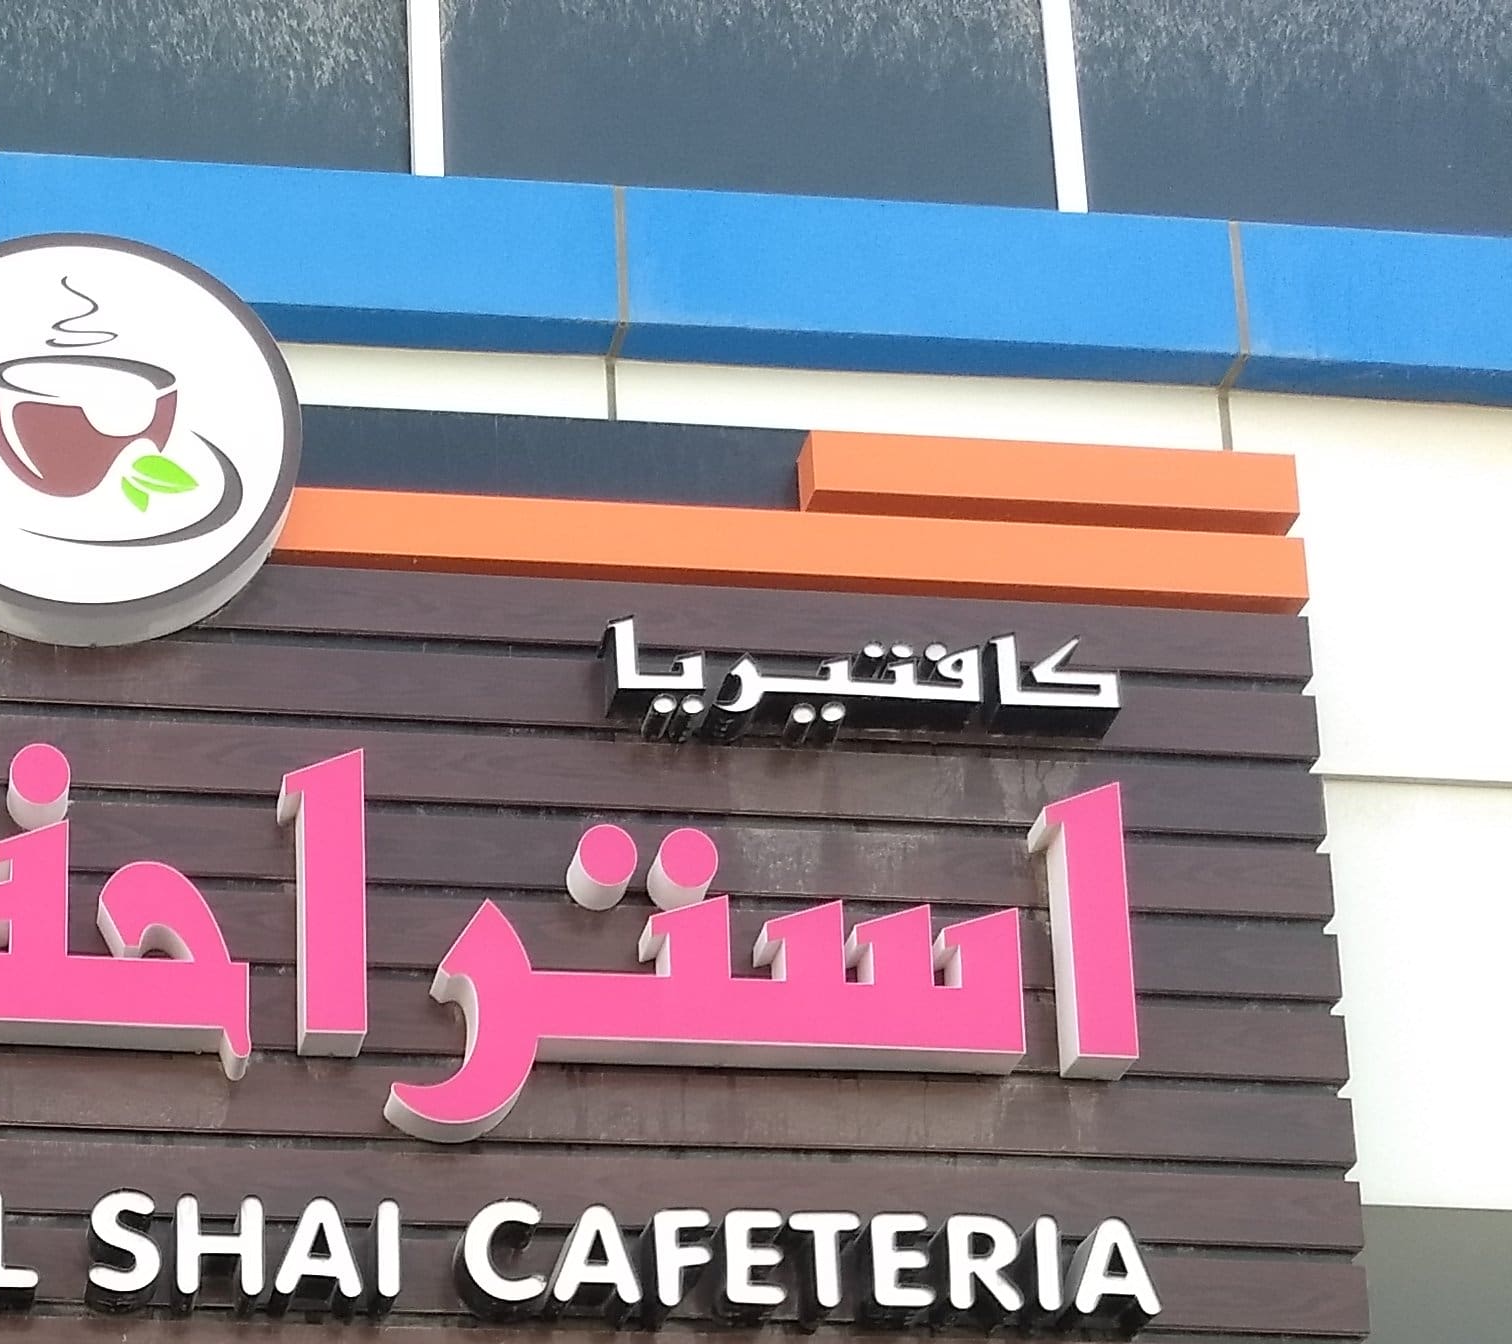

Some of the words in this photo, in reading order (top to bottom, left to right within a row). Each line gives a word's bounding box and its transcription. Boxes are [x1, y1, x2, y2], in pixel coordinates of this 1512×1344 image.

[603, 614, 1122, 726] كافتيريا
[87, 1189, 402, 1300] SHAI
[460, 1199, 1164, 1319] CAFETERIA
